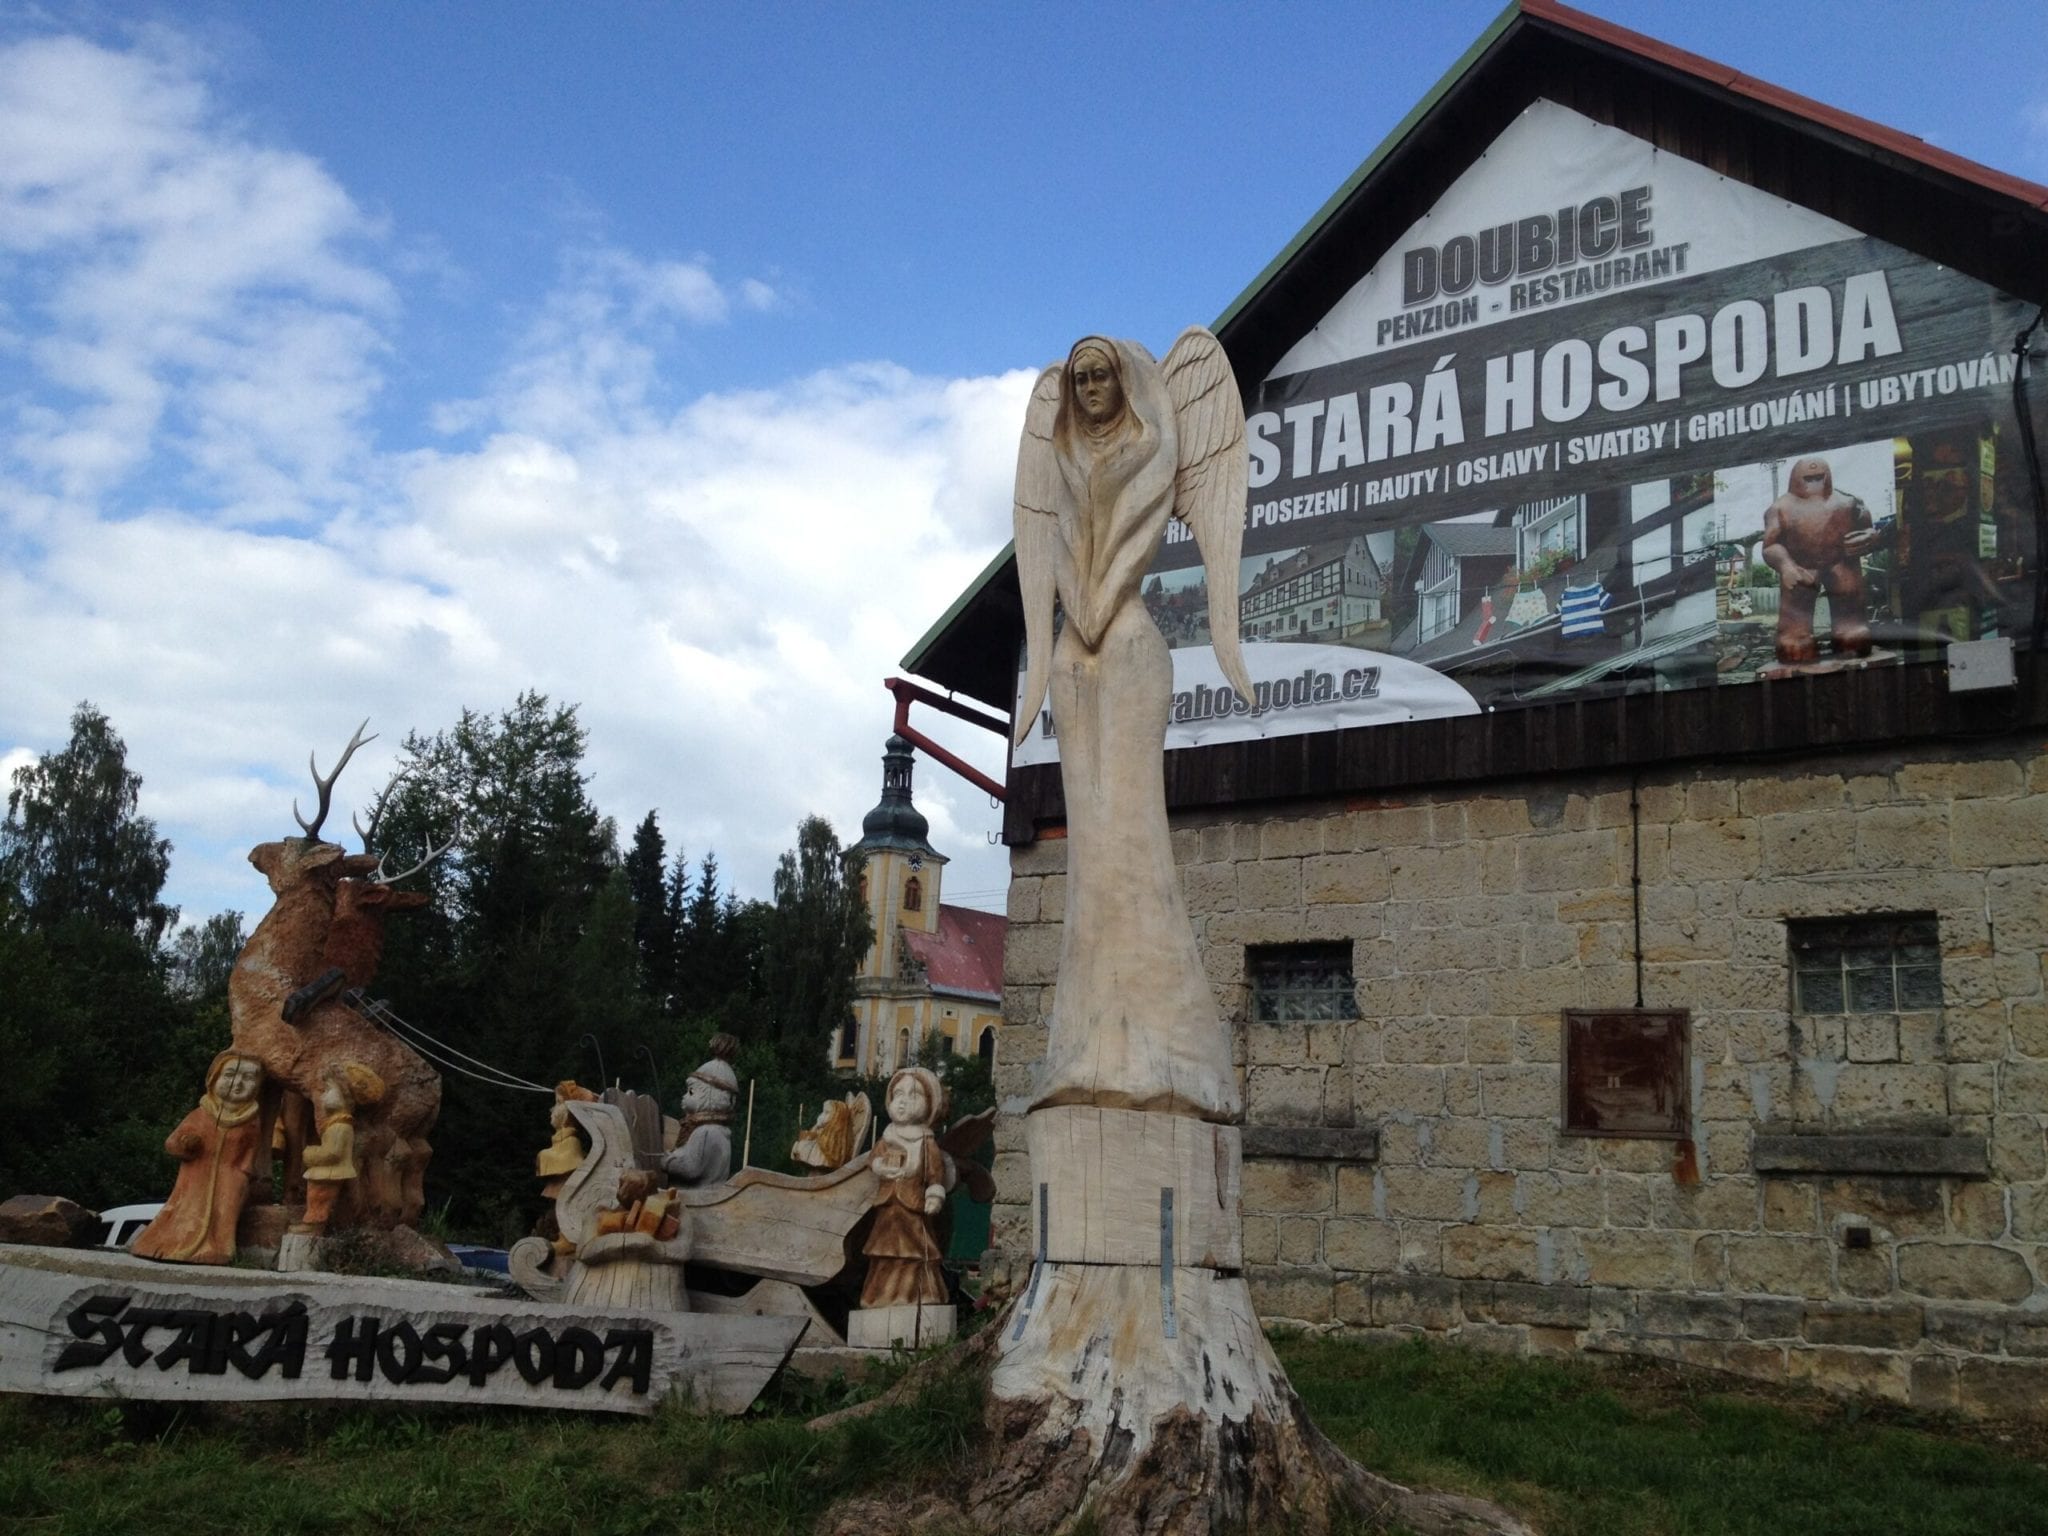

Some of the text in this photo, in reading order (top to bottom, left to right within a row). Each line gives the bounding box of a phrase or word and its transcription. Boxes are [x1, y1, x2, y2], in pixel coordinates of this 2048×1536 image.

[1376, 296, 1480, 346] PENZION
[1509, 242, 1690, 313] RESTAURANT
[1403, 185, 1652, 308] DOUBICE
[1246, 269, 1903, 489] STARÁ HOSPODA
[1251, 482, 1349, 529] POSEZENÍ
[1365, 467, 1439, 506] RAUTY
[1456, 444, 1548, 486] OSLAVY
[1567, 419, 1668, 465] SVATBY
[1688, 382, 1837, 442] GRILOVÁNÍ
[324, 1315, 655, 1395] HOSPODA
